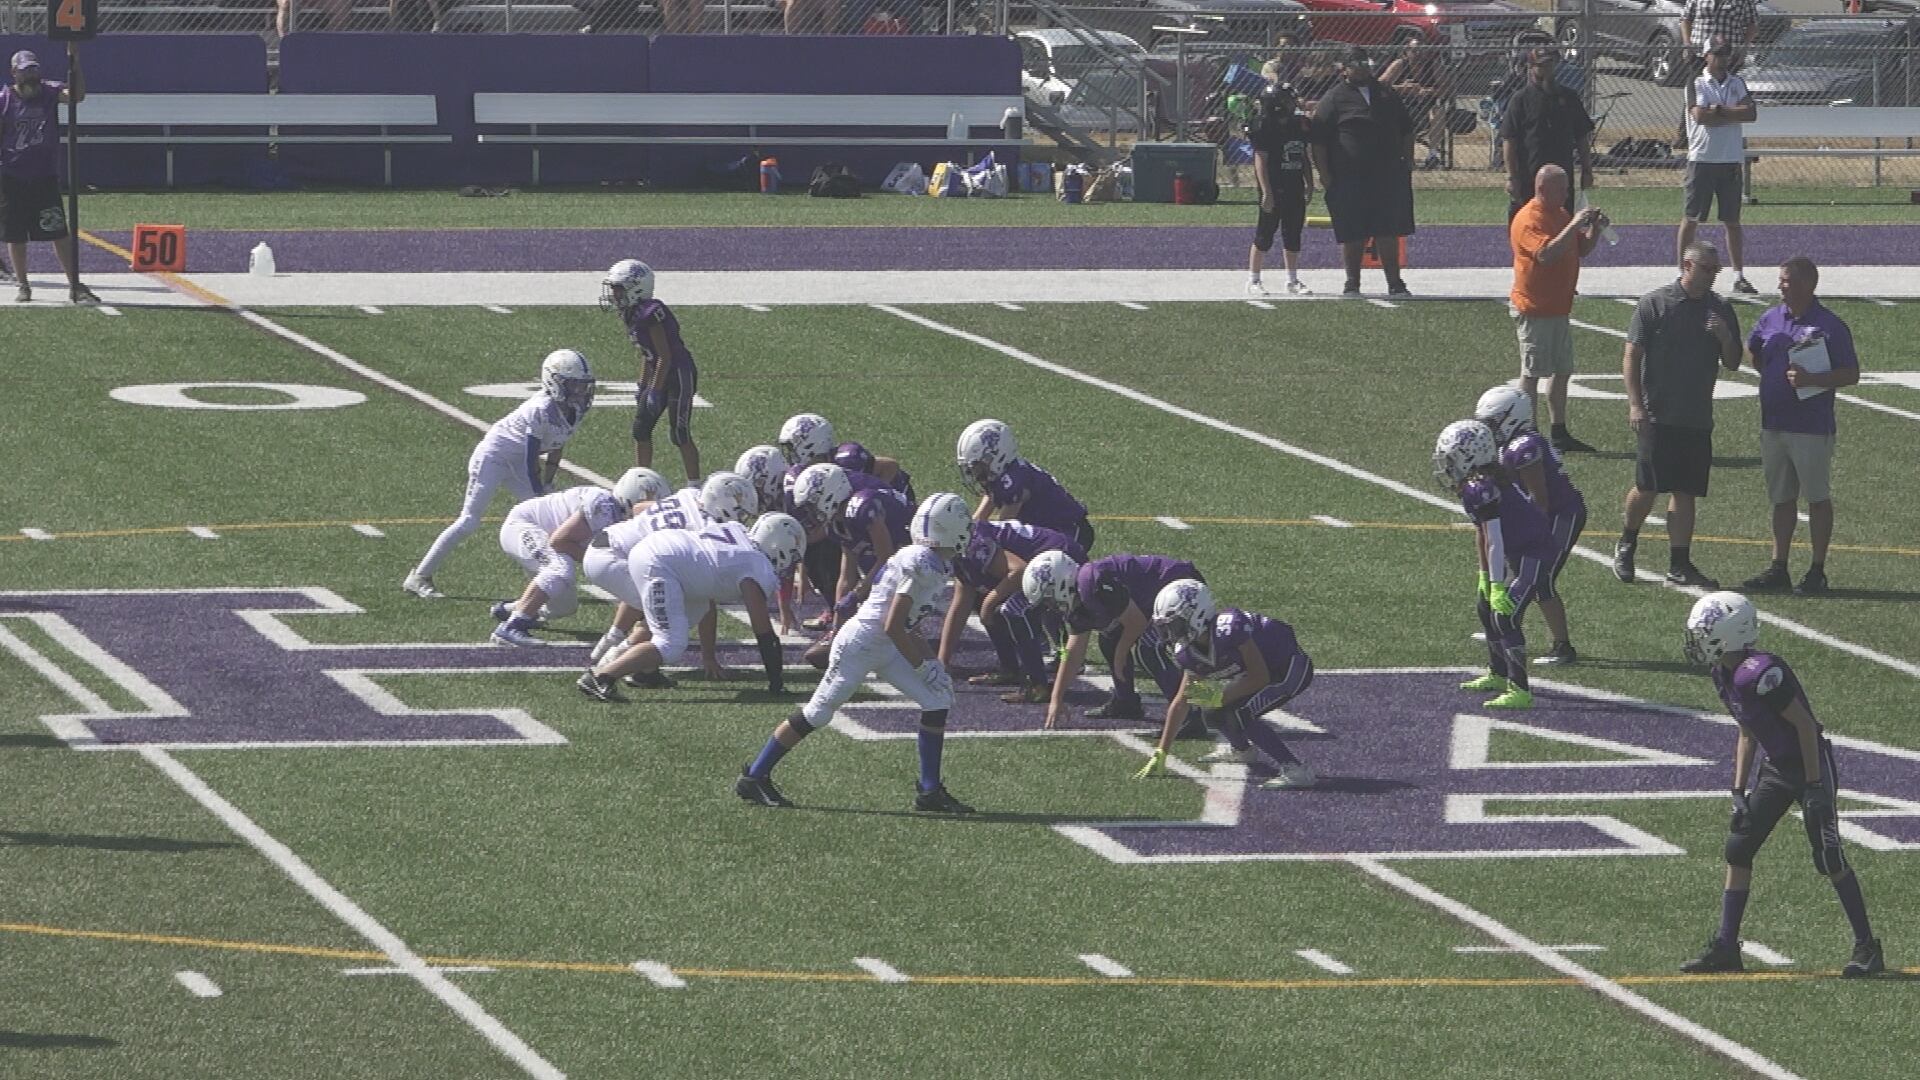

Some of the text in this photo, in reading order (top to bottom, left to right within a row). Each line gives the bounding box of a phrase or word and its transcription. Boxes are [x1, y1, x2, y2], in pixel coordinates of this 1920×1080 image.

[55, 0, 86, 31] 4
[138, 230, 178, 267] 50
[1001, 474, 1013, 489] 3
[699, 527, 739, 546] 7
[652, 580, 671, 630] HERMON
[1215, 612, 1234, 638] 39
